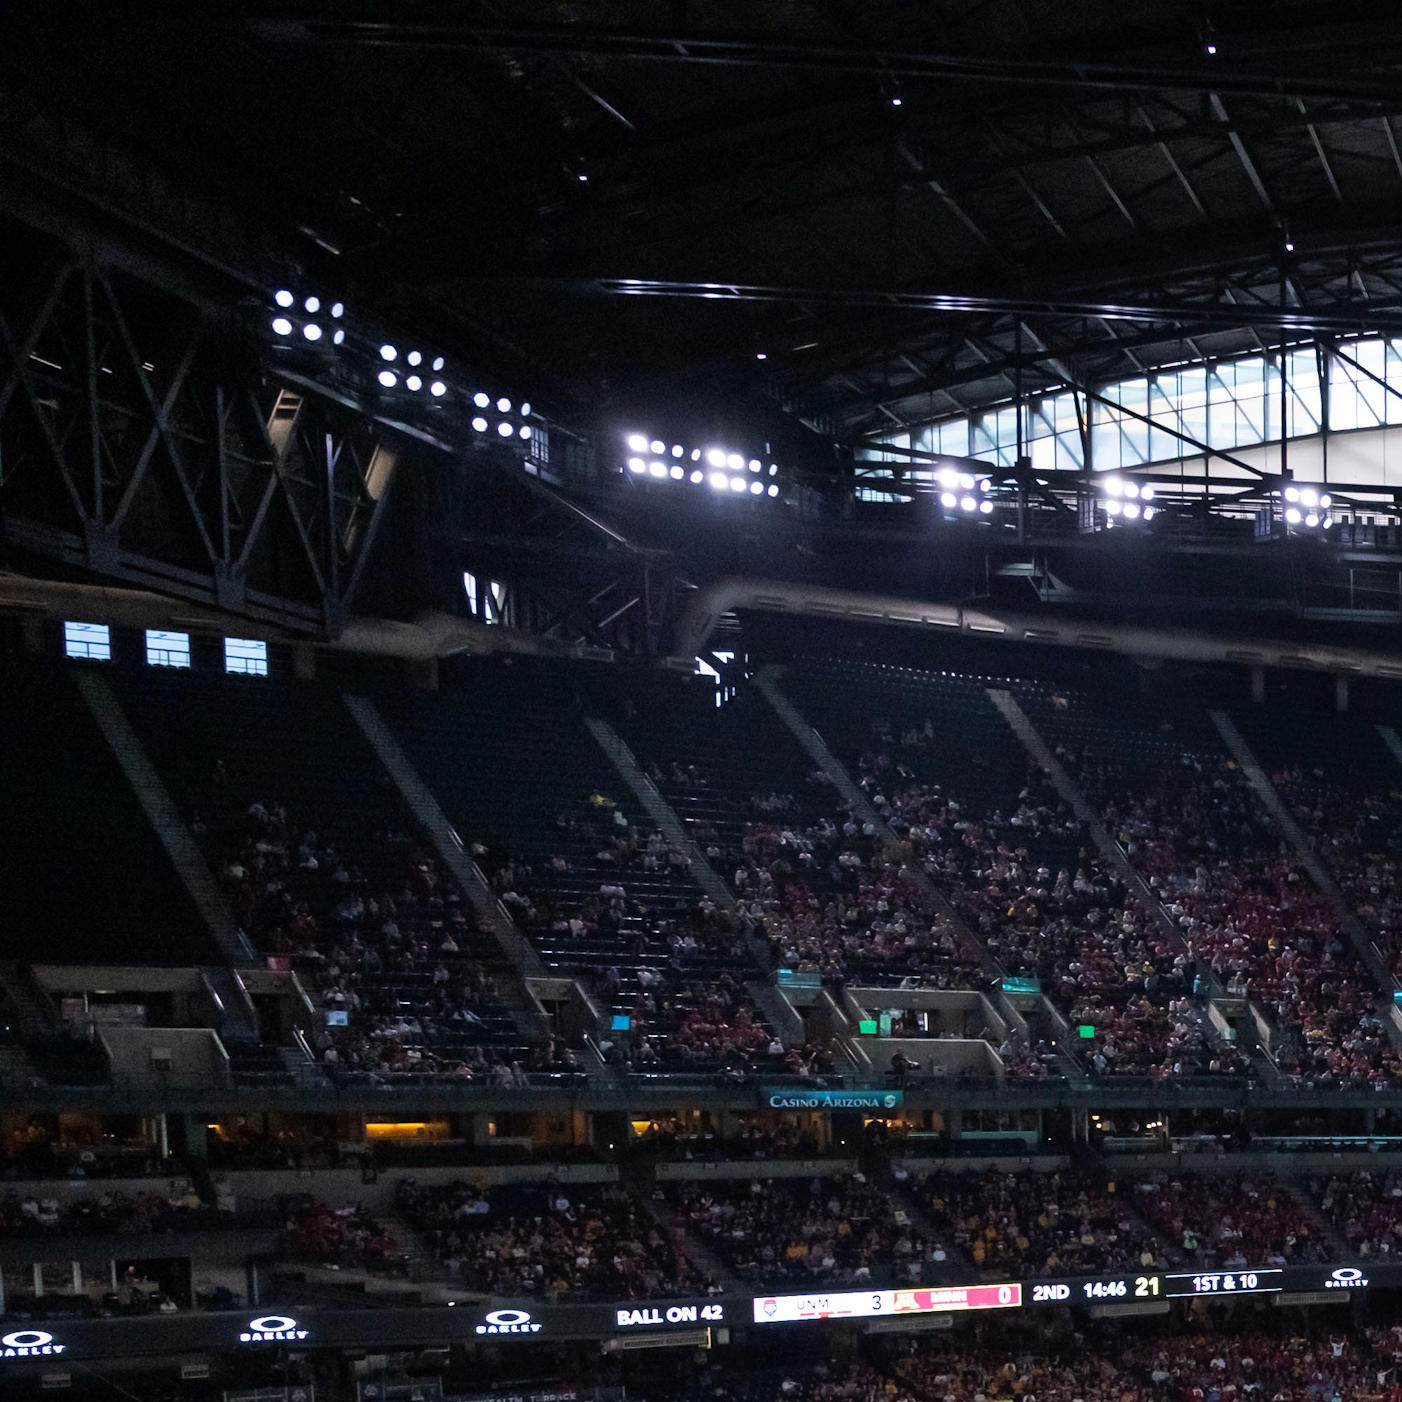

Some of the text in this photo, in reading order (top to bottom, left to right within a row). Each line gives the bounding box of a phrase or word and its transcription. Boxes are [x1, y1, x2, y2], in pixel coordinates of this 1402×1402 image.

[769, 1095, 880, 1108] CASINO ARIZONA
[1084, 1280, 1127, 1298] 14:46
[1135, 1277, 1160, 1296] 21
[1193, 1273, 1258, 1292] 1ST & 10
[1324, 1279, 1369, 1288] OAKLEY
[998, 1286, 1012, 1303] 0
[1032, 1284, 1071, 1300] 2ND
[871, 1294, 883, 1310] 3
[616, 1304, 724, 1326] BALL ON 42
[239, 1330, 309, 1342] OAKLEY
[475, 1323, 543, 1335] OAKLEY
